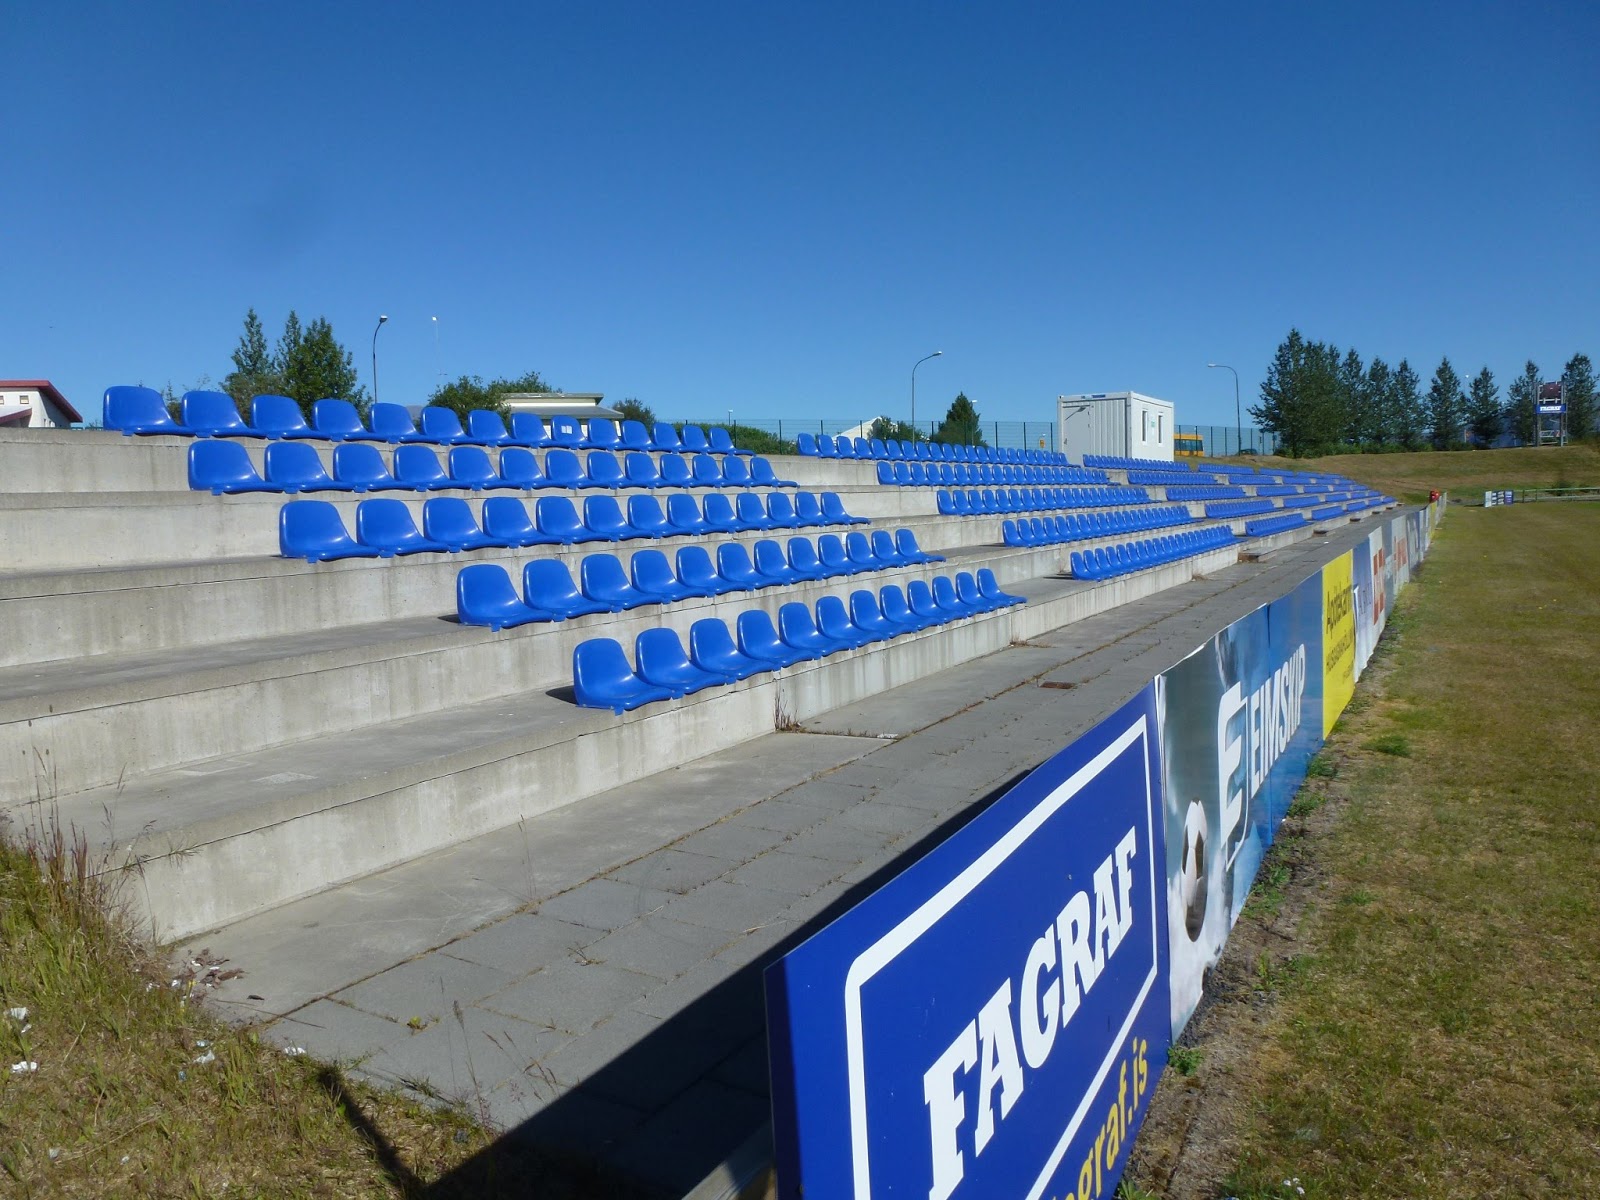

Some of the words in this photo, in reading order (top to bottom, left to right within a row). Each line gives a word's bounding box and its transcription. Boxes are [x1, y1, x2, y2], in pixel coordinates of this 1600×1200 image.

[1250, 643, 1306, 800] EIMSKIP
[923, 826, 1137, 1200] FAGRAF
[1051, 1036, 1148, 1200] graf.is
